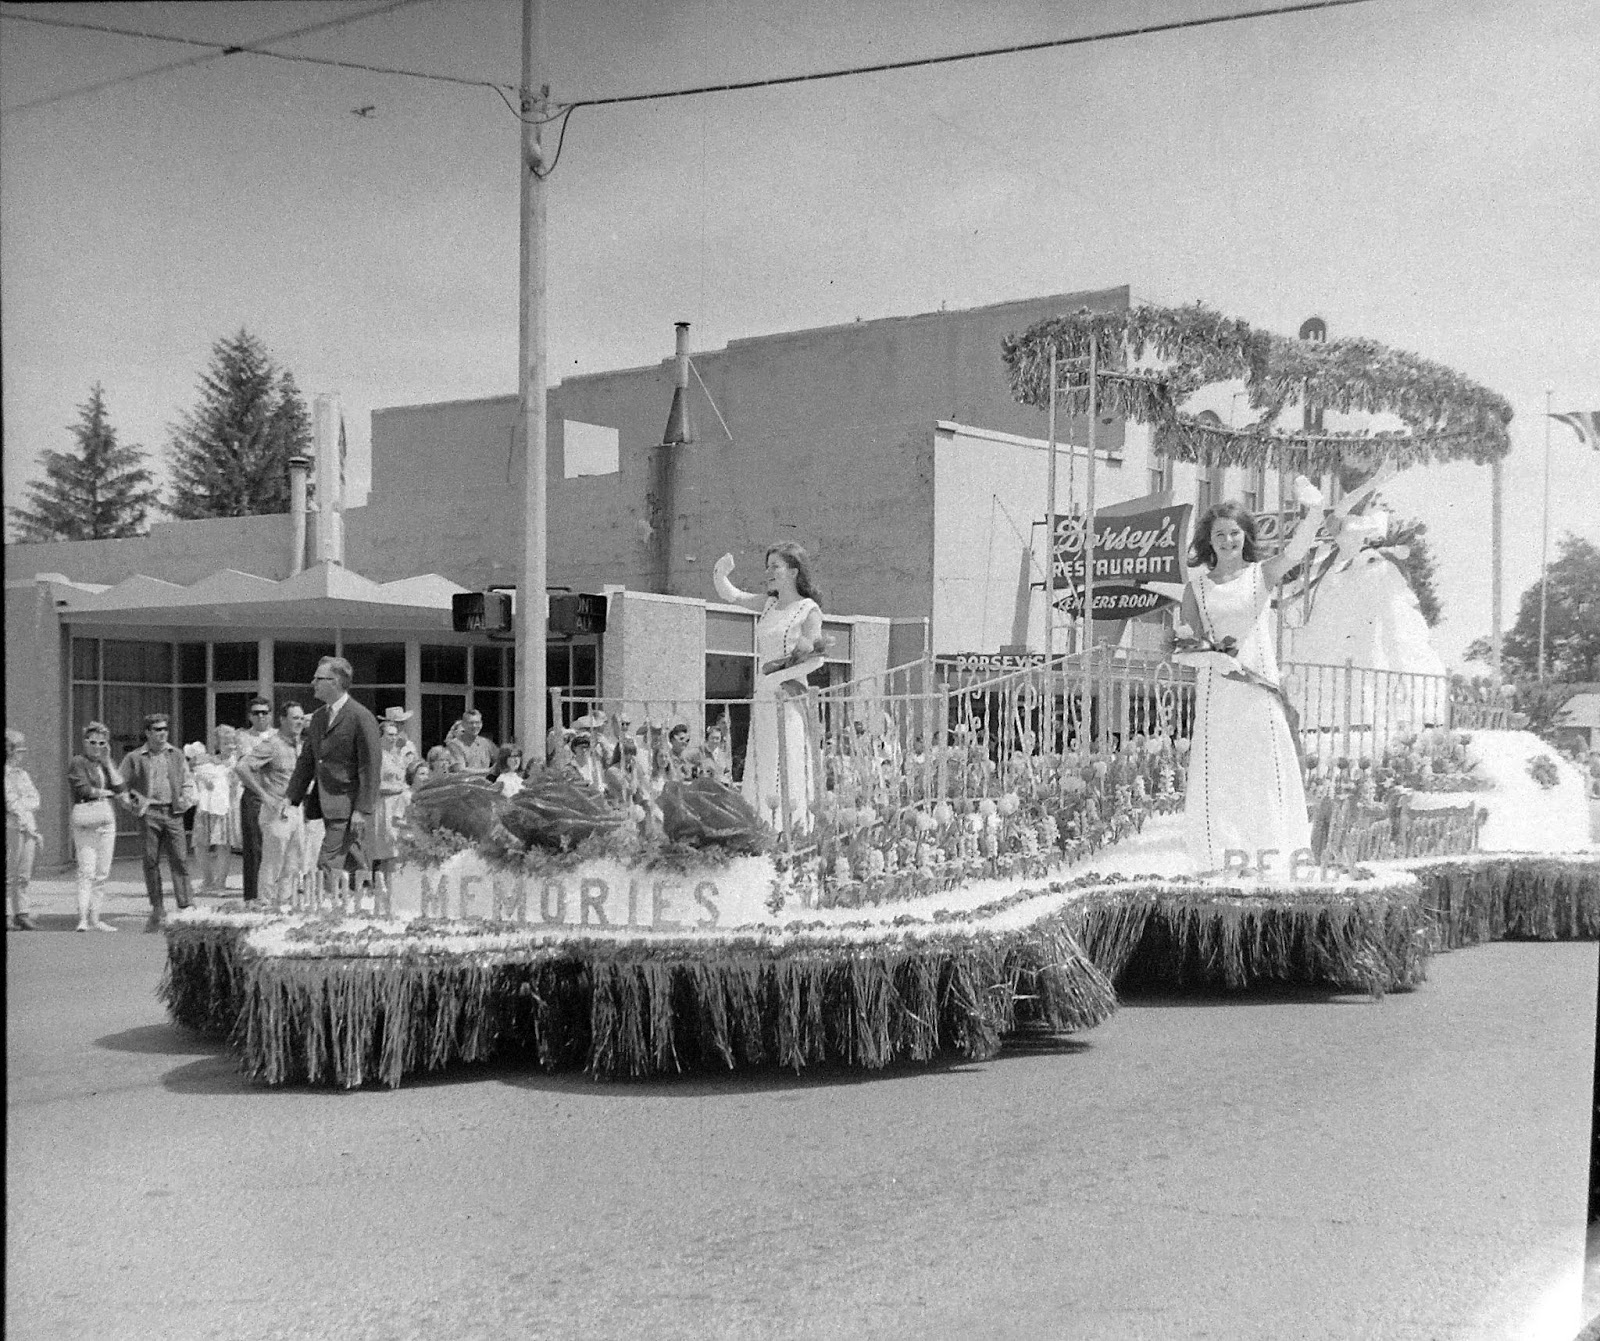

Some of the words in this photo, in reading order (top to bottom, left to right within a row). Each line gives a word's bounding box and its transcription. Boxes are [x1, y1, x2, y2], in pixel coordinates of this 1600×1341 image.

[1118, 593, 1159, 609] ROOM
[956, 655, 1045, 671] DORSEY'S
[421, 875, 720, 927] MEMORIES
